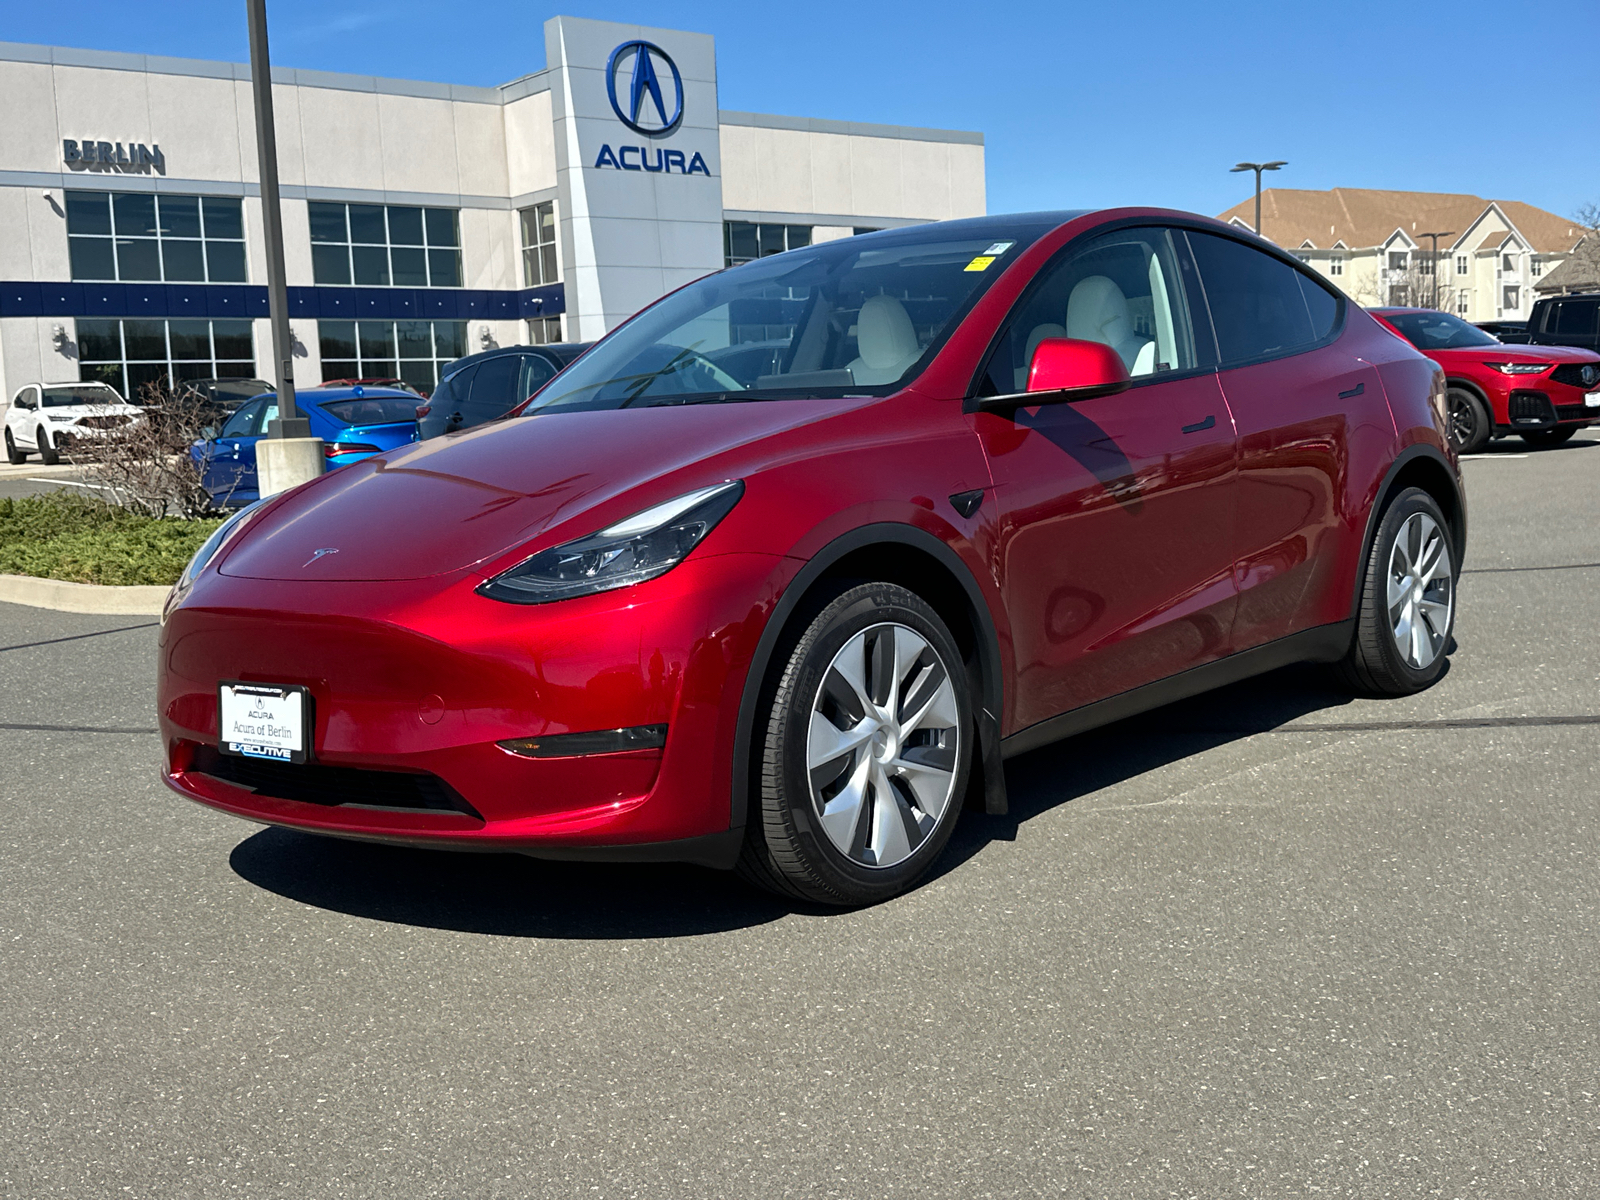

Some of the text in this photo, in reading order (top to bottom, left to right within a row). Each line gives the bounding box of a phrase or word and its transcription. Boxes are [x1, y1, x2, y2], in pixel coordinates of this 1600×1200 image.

[62, 138, 161, 167] BERLIN
[594, 143, 711, 177] ACURA
[248, 710, 275, 721] ACURA
[233, 720, 292, 739] Acura of Berlin
[229, 742, 292, 759] EXECUTIVE
